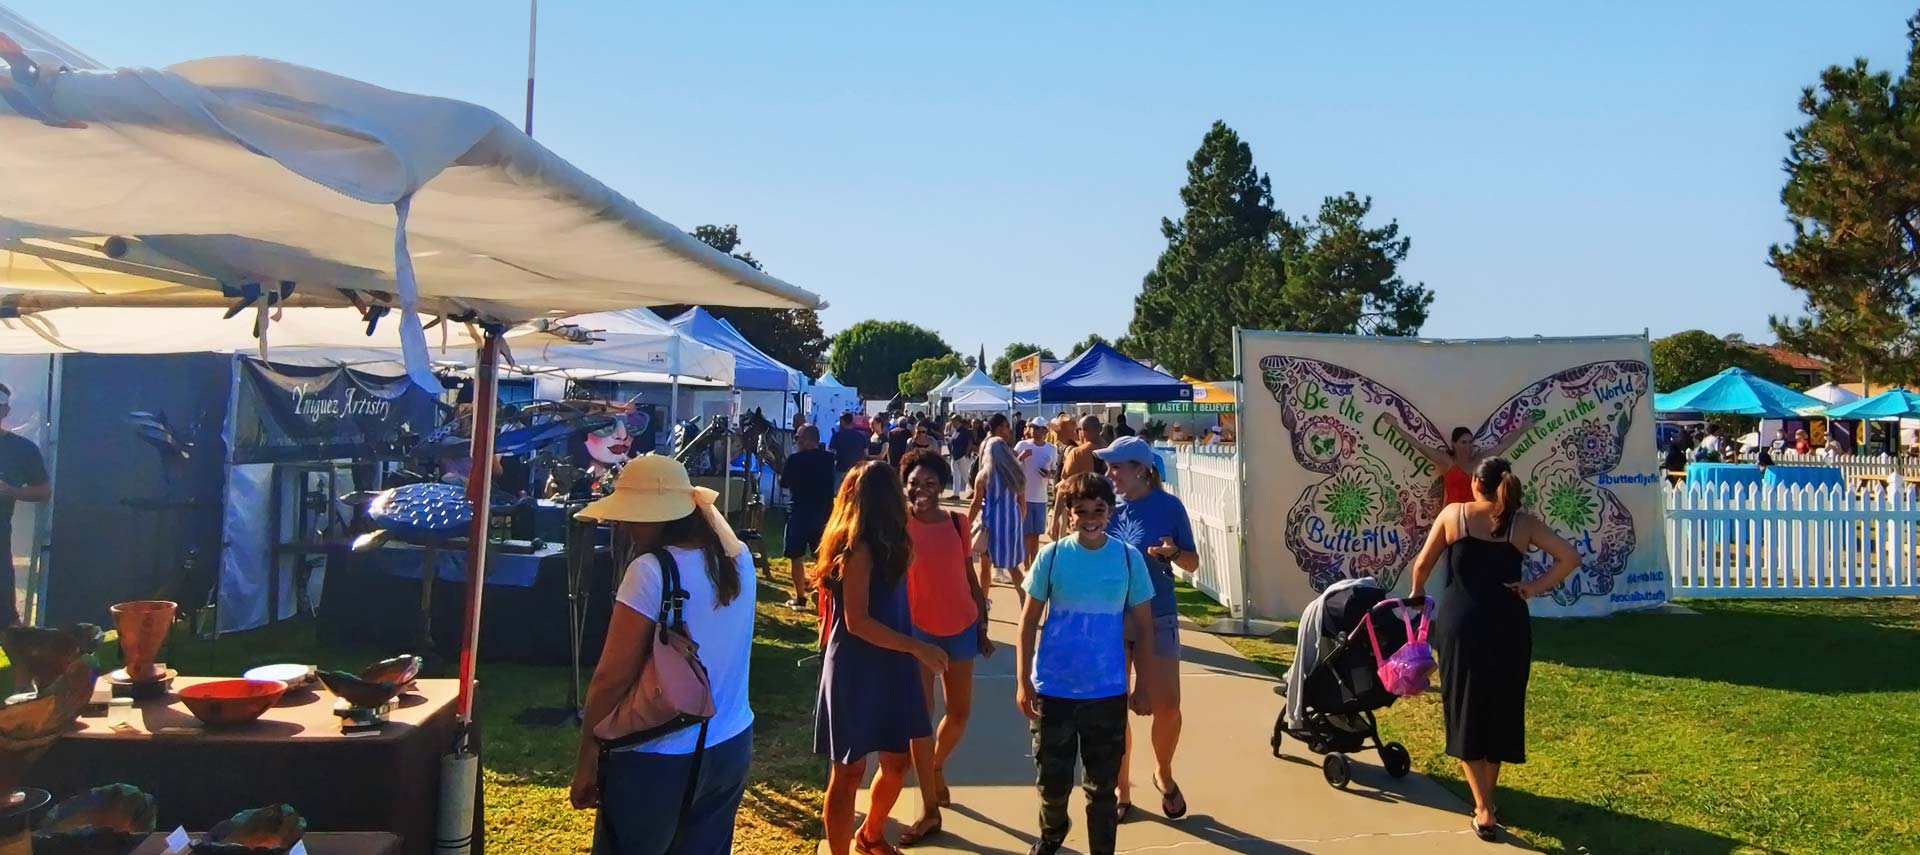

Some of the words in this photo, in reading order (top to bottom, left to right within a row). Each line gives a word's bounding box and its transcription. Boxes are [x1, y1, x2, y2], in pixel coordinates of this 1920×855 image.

[292, 383, 339, 422] Yniguez
[340, 387, 391, 421] Artistry
[1157, 403, 1180, 412] TASTE
[1182, 403, 1189, 412] IT
[1199, 403, 1231, 412] BELIEVE
[1510, 433, 1536, 460] want
[1534, 425, 1548, 441] to
[1547, 416, 1564, 431] see
[1574, 395, 1596, 415] the
[1594, 375, 1633, 403] World
[1296, 380, 1328, 410] Be
[1339, 395, 1365, 424] the
[1372, 412, 1436, 478] Change
[1305, 515, 1401, 557] Butterfly
